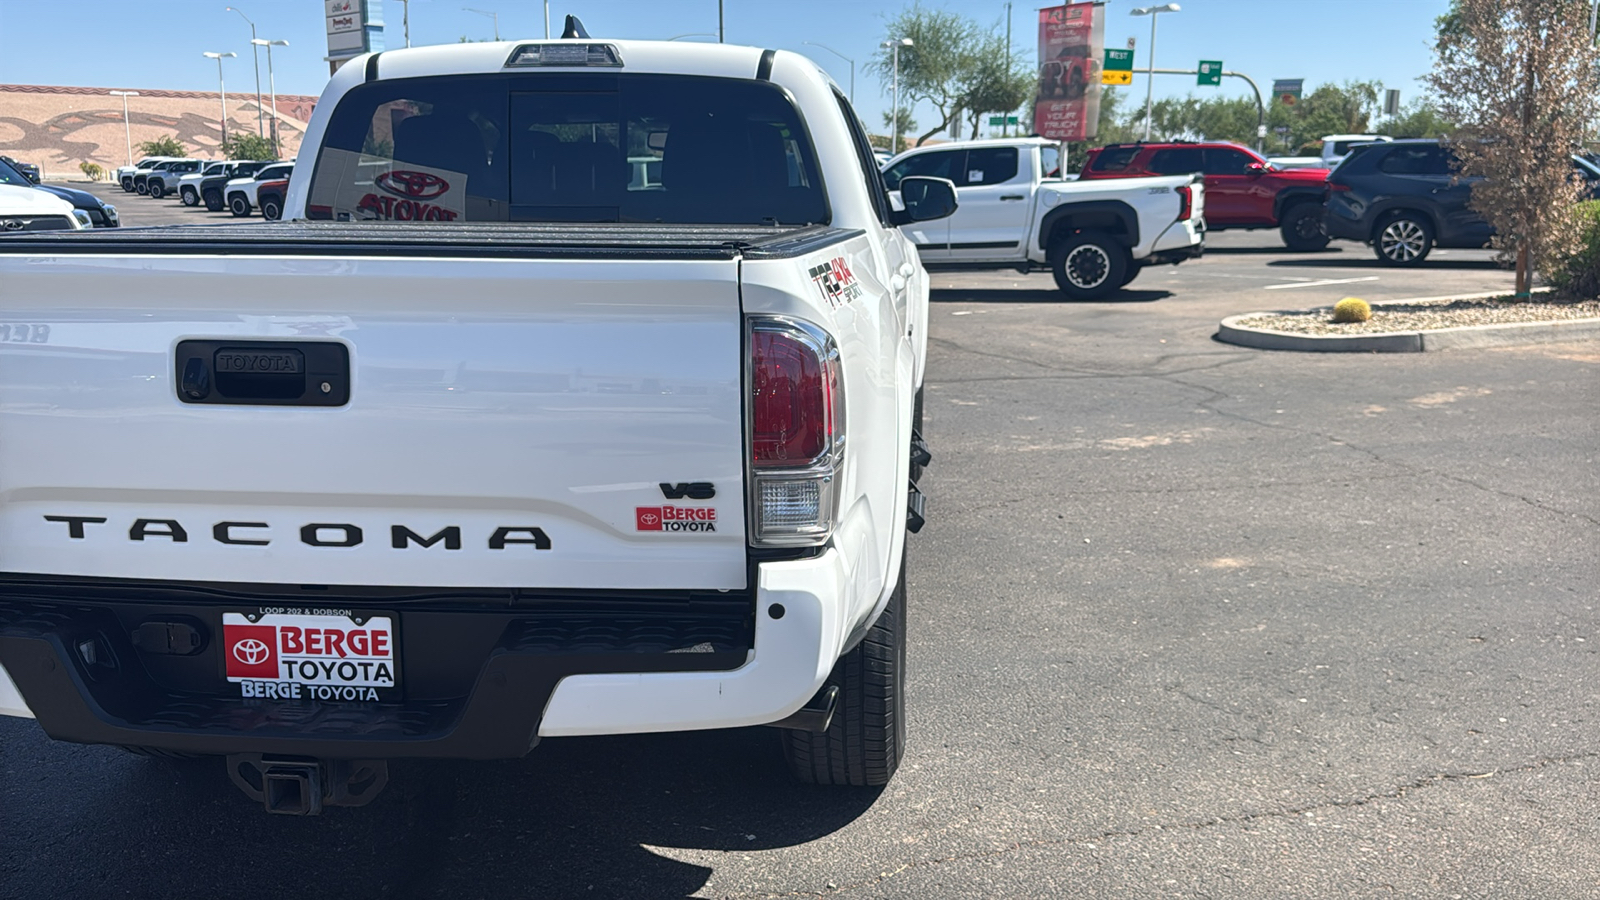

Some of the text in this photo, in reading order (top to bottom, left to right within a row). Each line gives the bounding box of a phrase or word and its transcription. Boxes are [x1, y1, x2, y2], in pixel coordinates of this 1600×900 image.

[1109, 51, 1128, 60] WEST
[1050, 103, 1073, 112] GET
[1046, 112, 1077, 120] YOUR
[1044, 120, 1079, 129] TRUCK
[843, 281, 862, 304] SPORT
[220, 355, 295, 371] TOYOTA
[659, 482, 716, 499] V6
[663, 505, 716, 521] BERGE
[43, 515, 552, 551] TACOMA
[663, 521, 716, 532] TOYOTA
[313, 608, 352, 616] DOBSON
[280, 626, 390, 658] BERGE
[282, 660, 393, 682] TOYOTA
[241, 680, 379, 701] BERGE TOYOTA
